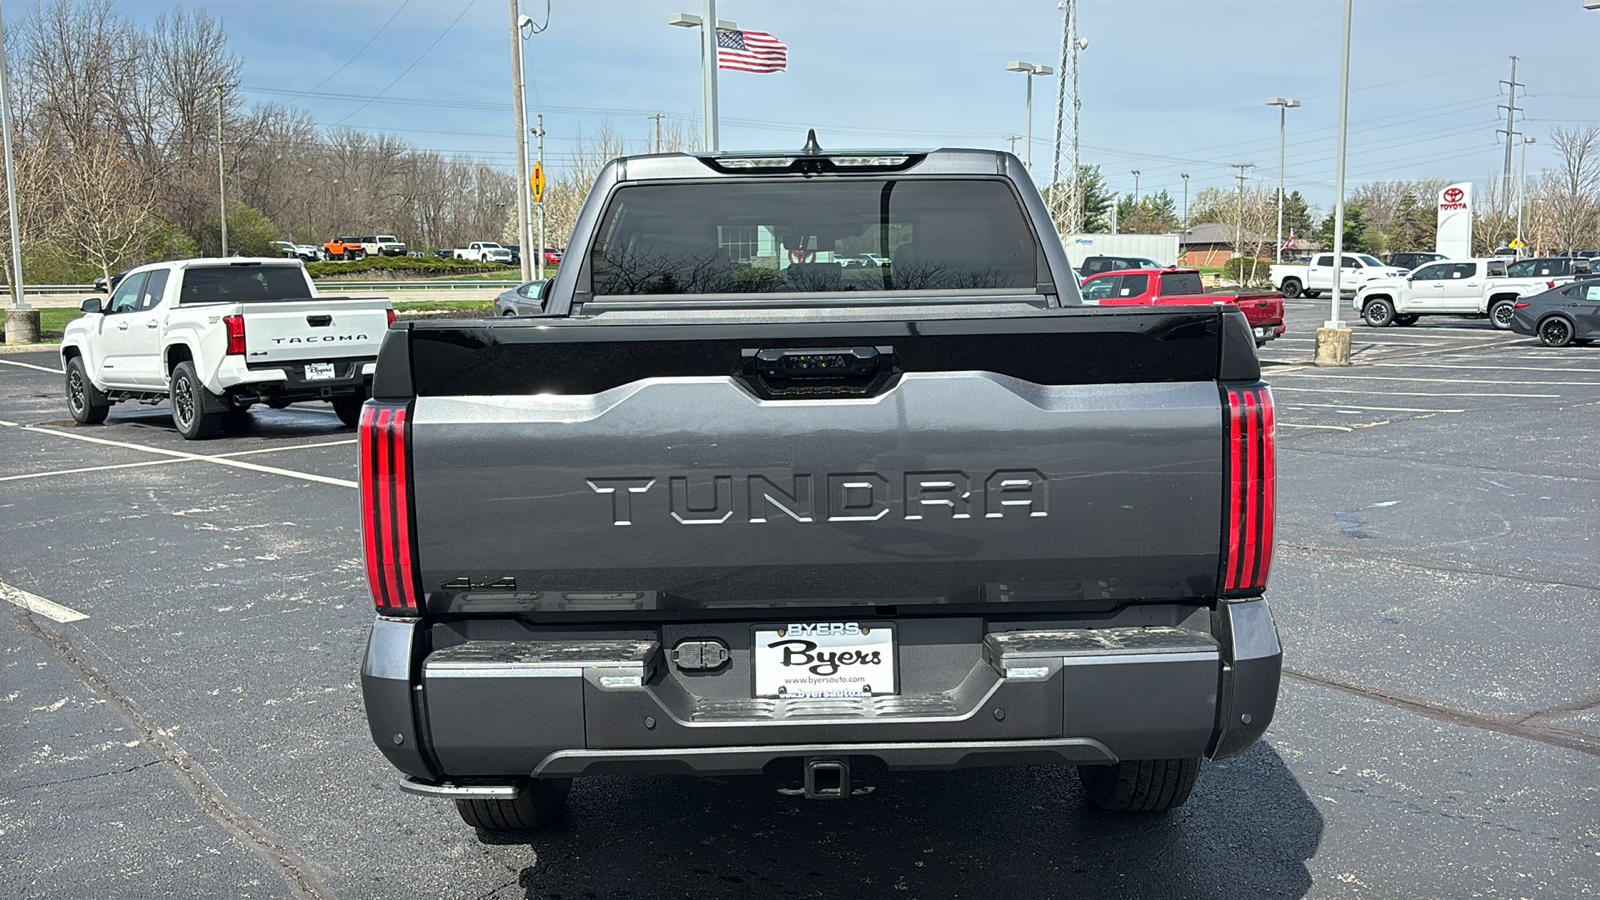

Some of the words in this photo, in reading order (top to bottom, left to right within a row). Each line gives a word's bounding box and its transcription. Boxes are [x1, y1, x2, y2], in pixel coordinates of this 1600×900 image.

[1440, 203, 1467, 211] TOYOTA
[272, 334, 368, 344] TACOMA
[586, 468, 1049, 527] TUNDRA
[787, 622, 861, 636] BYERS
[767, 639, 881, 676] Byers
[784, 676, 866, 686] www.byersauto.com
